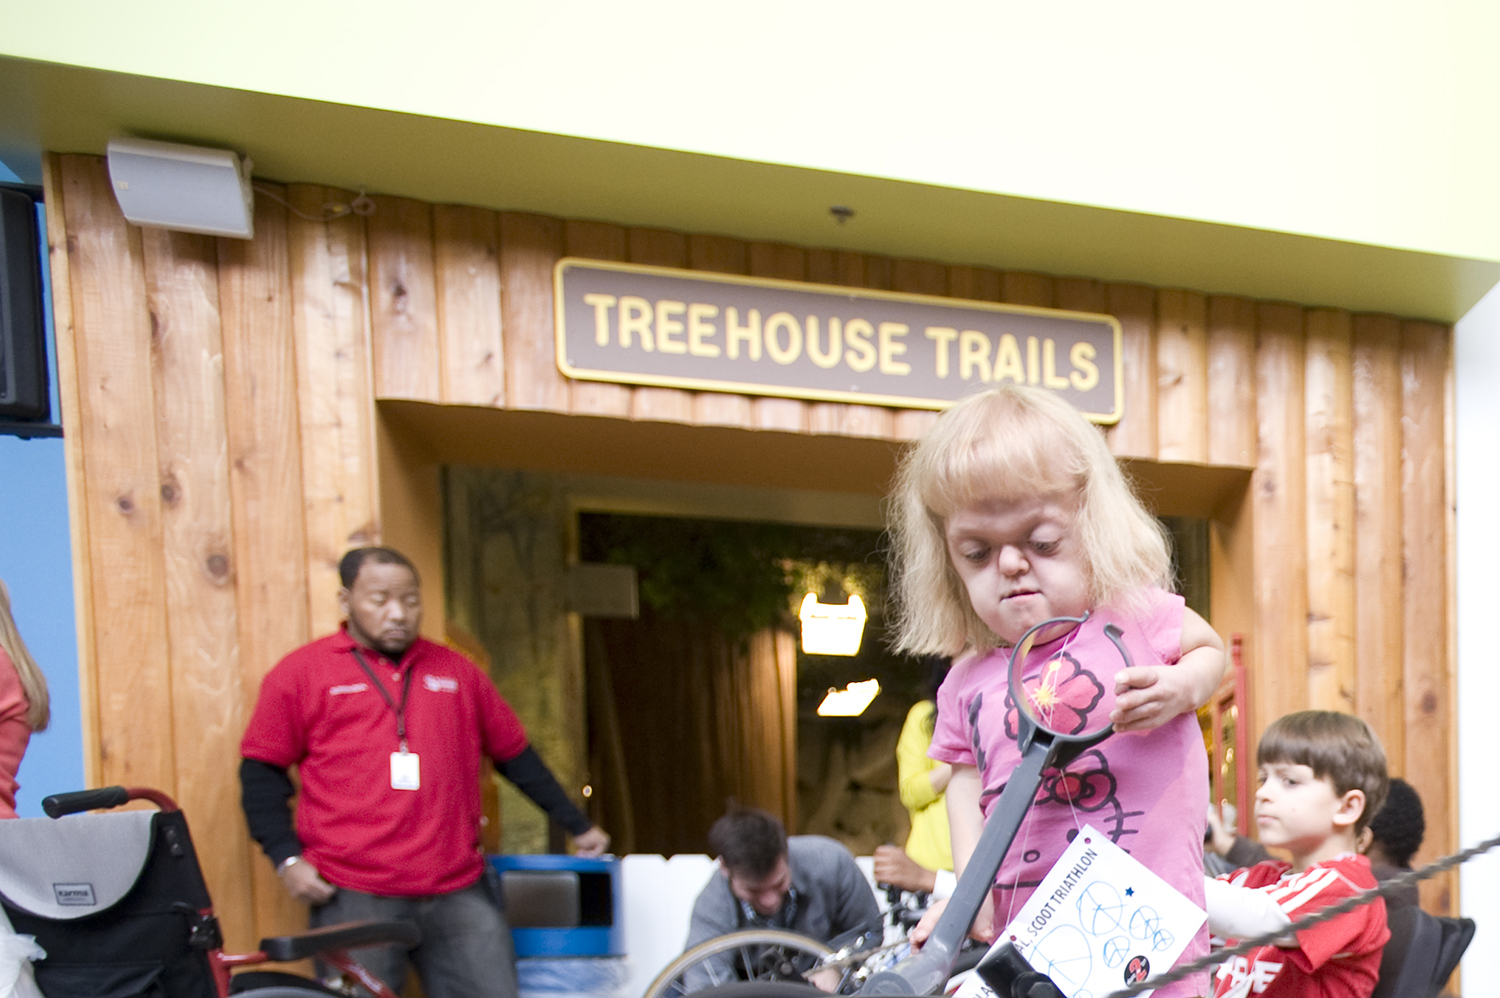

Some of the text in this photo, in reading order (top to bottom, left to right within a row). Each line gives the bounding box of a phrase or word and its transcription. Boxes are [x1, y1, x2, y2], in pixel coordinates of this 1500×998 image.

[583, 293, 1100, 391] TREEHOUSE TRAILS
[1027, 902, 1056, 937] SCOOT
[1050, 848, 1098, 910] TRIATHLON
